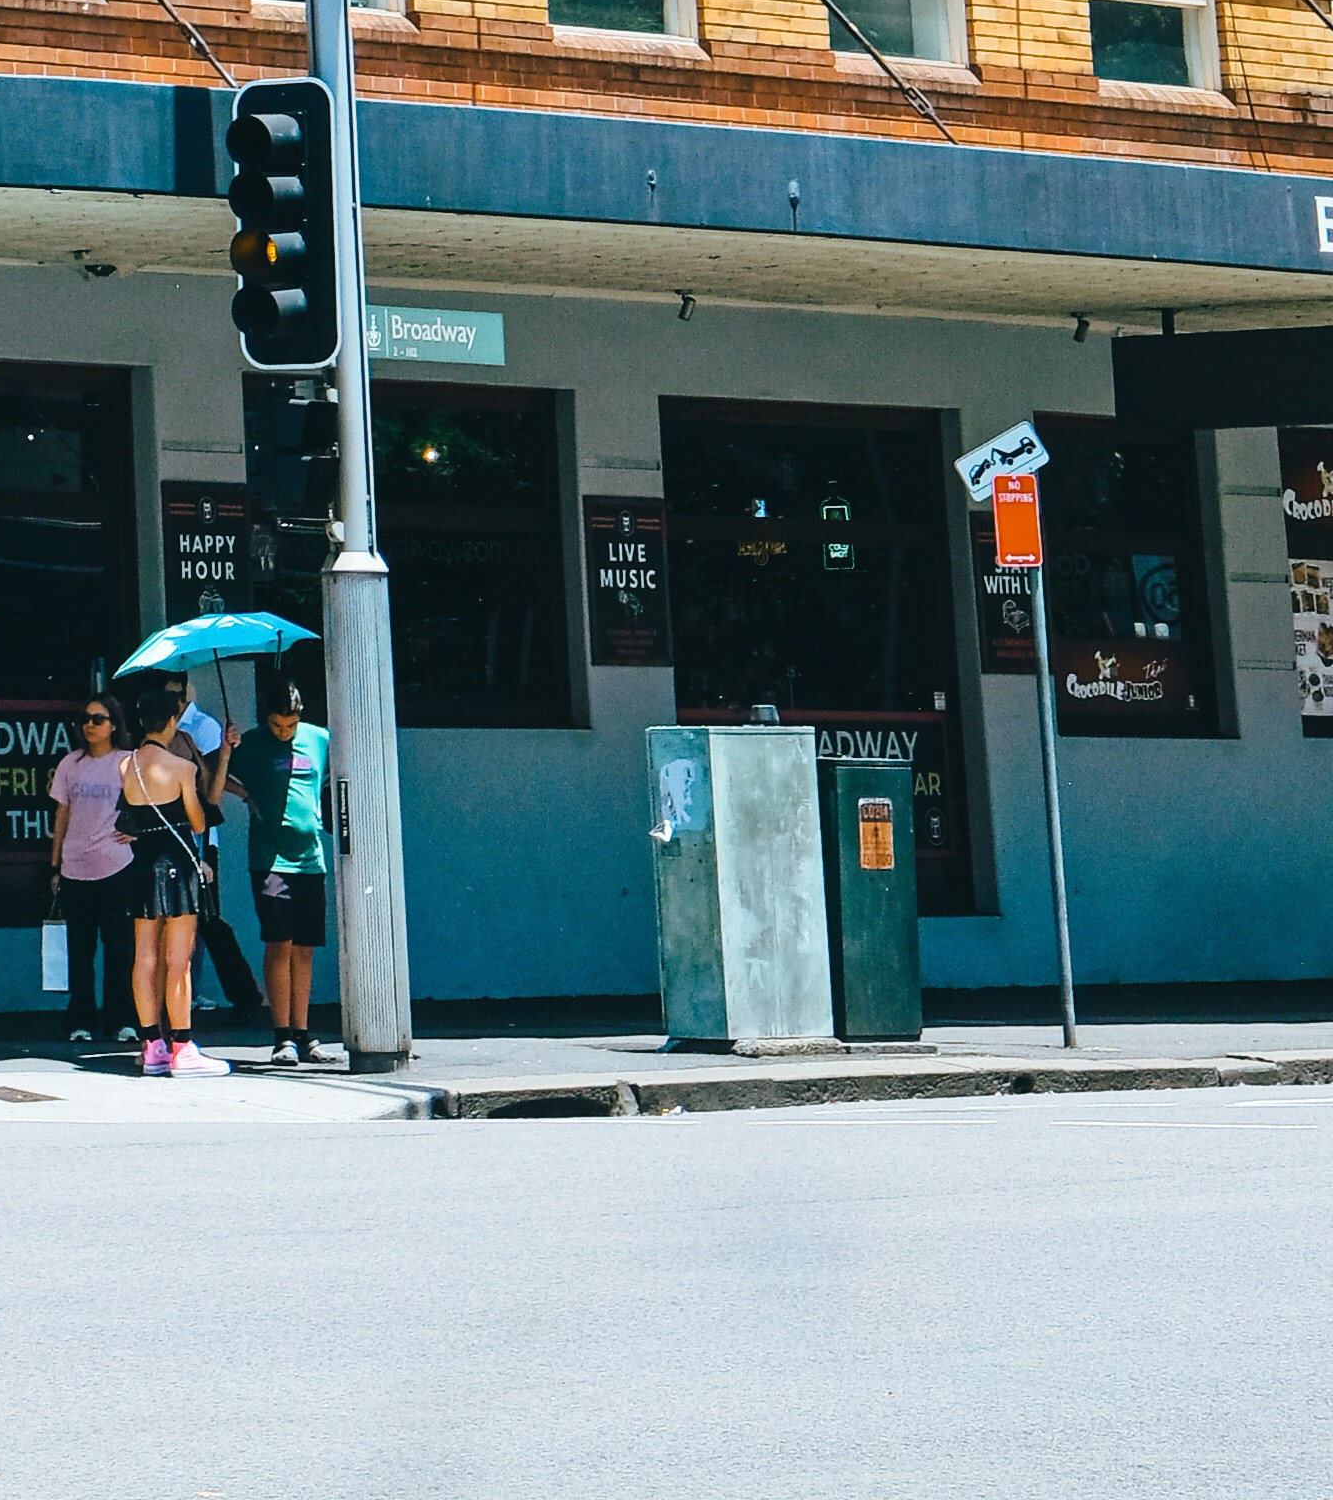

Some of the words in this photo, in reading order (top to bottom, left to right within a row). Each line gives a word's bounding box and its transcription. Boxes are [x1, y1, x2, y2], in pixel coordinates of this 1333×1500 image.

[391, 314, 477, 351] Broadway
[1008, 480, 1021, 491] NO
[998, 492, 1034, 503] STOPPING
[1283, 488, 1333, 521] CROCOD
[179, 534, 235, 554] HAPPY
[608, 542, 647, 563] LIVE
[181, 560, 235, 580] HOUR
[600, 569, 656, 589] MUSIC
[984, 575, 1020, 594] WITH
[1066, 673, 1124, 701] CROCODILE
[818, 730, 918, 761] ADWAY
[914, 772, 941, 796] AR
